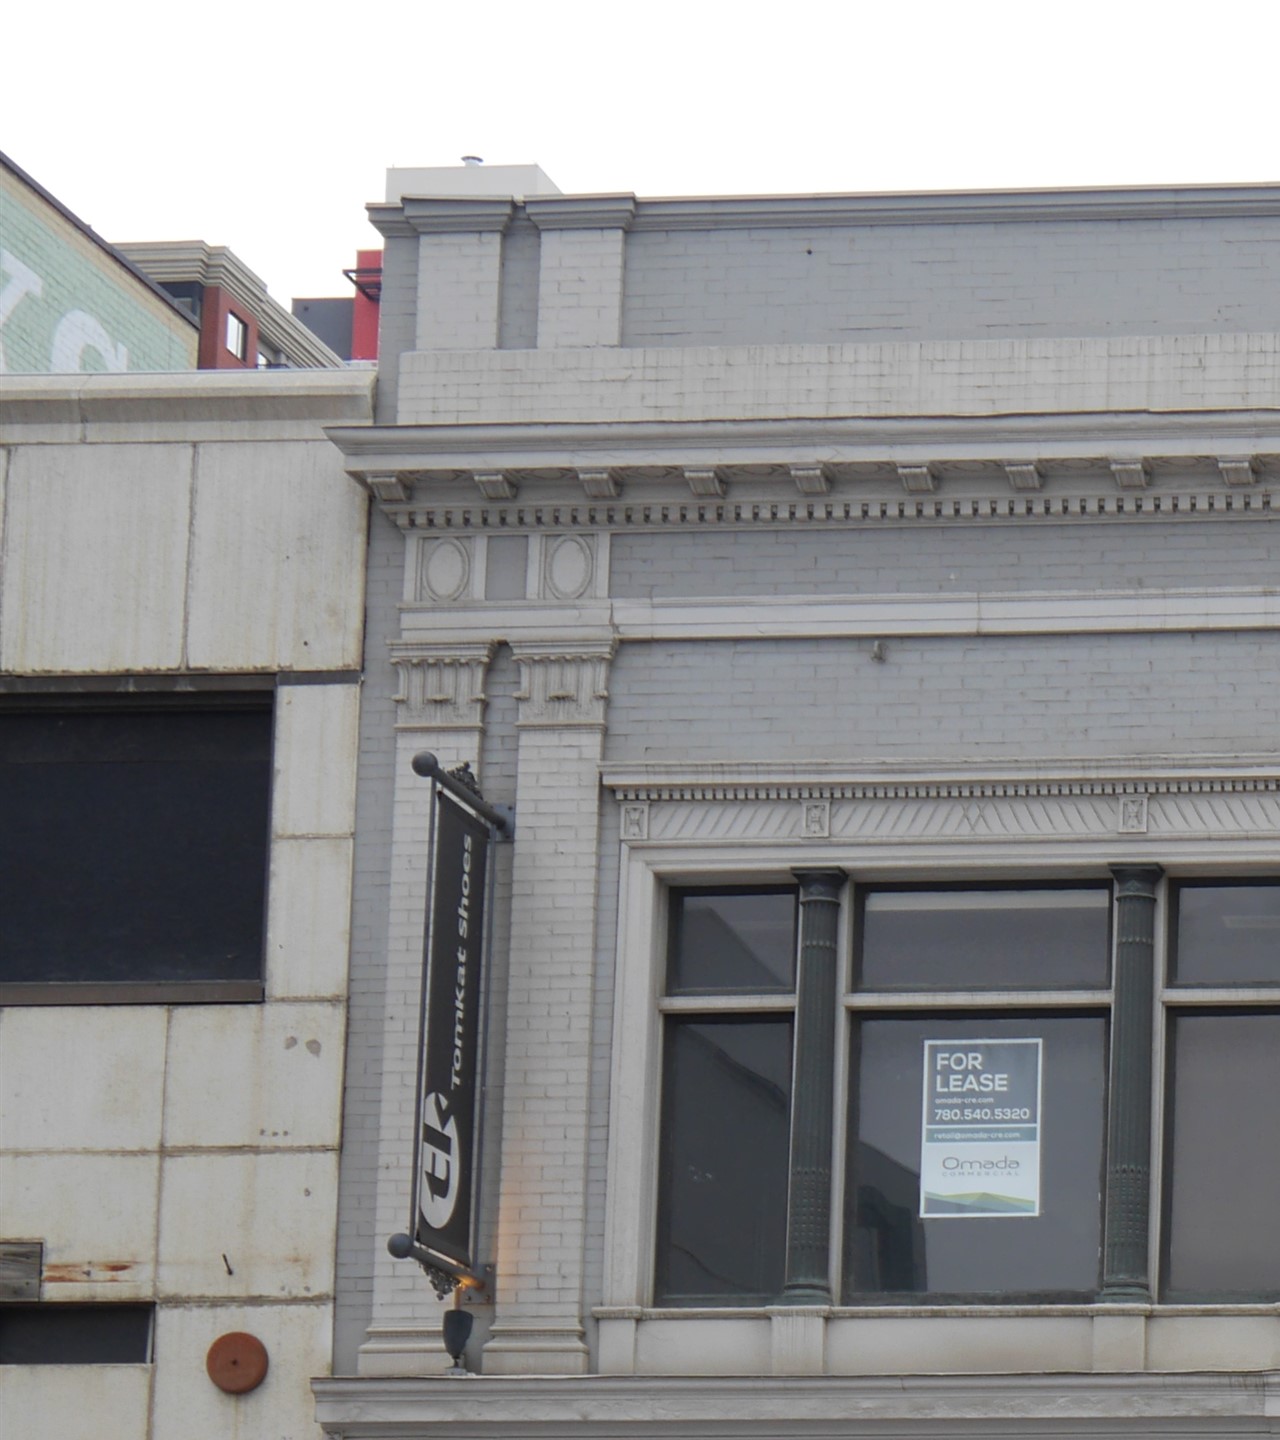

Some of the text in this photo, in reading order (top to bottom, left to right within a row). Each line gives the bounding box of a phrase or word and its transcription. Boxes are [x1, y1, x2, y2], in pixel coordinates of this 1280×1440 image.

[450, 945, 470, 1090] TomKat
[935, 1052, 984, 1071] FOR
[935, 1073, 1009, 1092] LEASE
[934, 1108, 1030, 1121] 780.540.5320
[941, 1155, 1021, 1171] Omada
